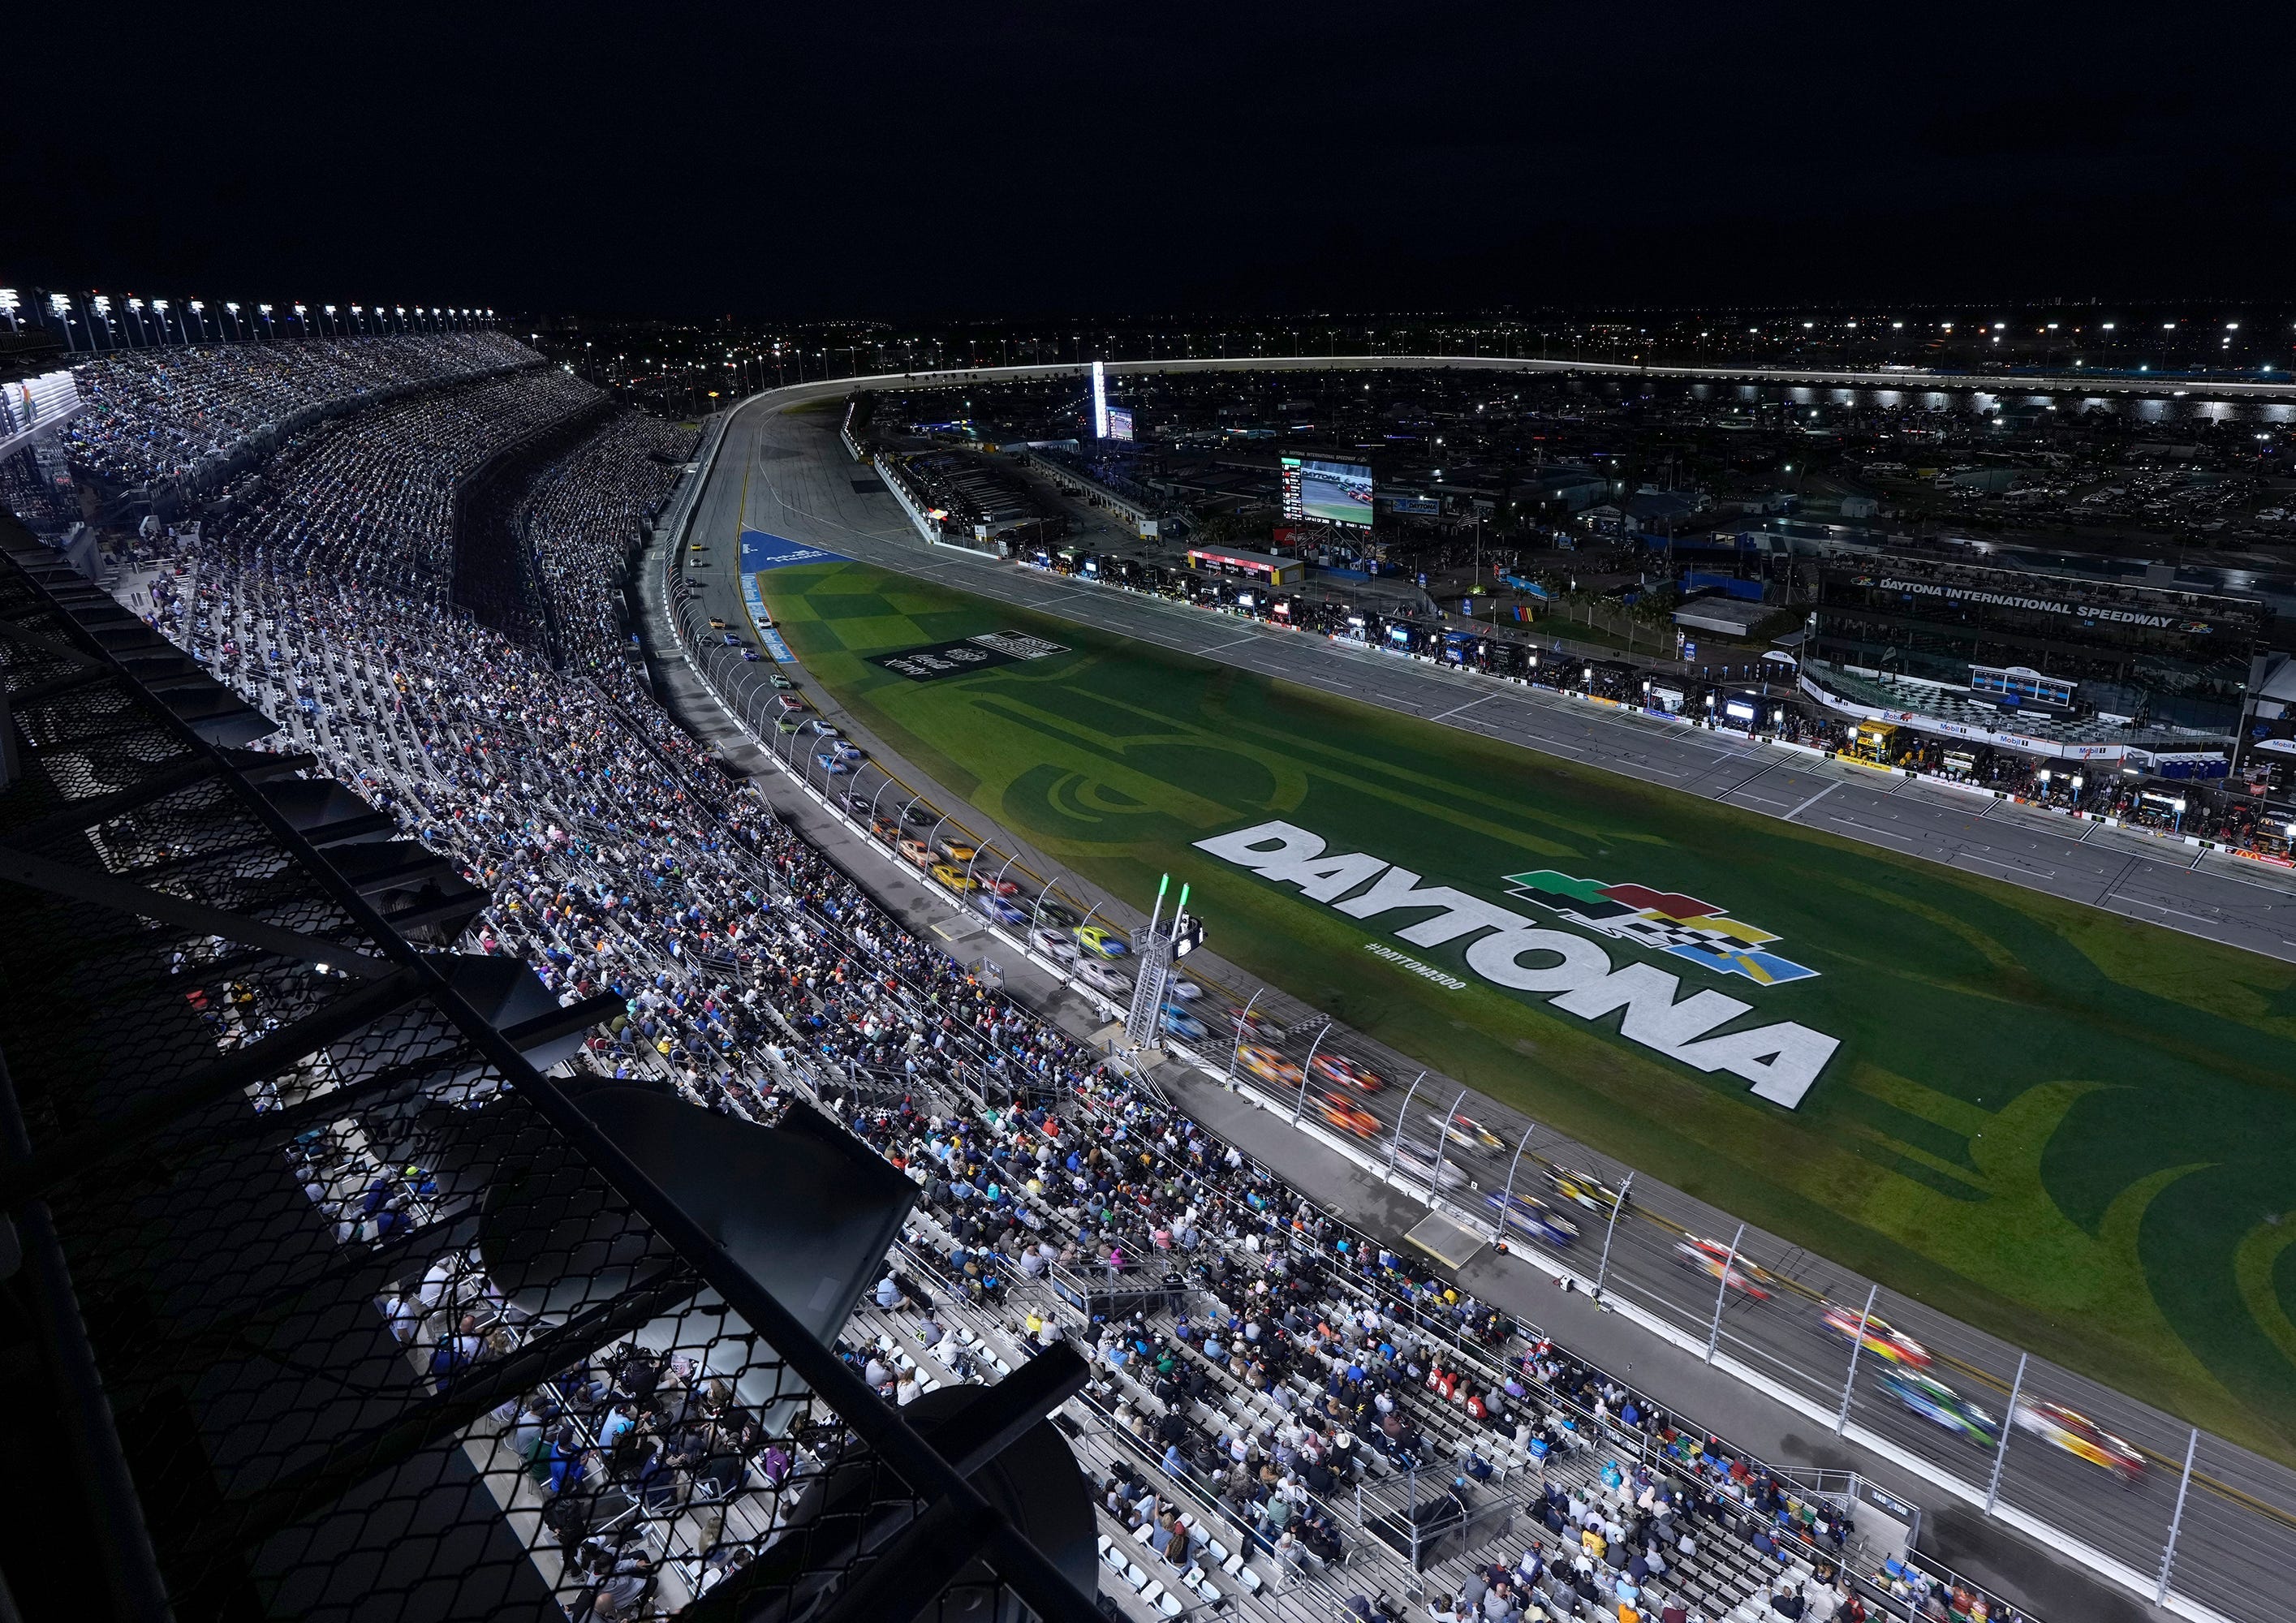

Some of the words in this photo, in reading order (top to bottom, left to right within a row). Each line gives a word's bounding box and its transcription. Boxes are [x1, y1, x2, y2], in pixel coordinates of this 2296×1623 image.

[1302, 471, 1341, 481] DAYTONA
[1880, 579, 1942, 596] DAYTONA
[1945, 588, 2071, 614] INTERNATIONAL
[2076, 606, 2174, 628] SPEEDWAY
[883, 657, 931, 676] xfinity
[1884, 711, 1900, 721] Mobil
[1940, 723, 1959, 732] Mobil
[2000, 735, 2021, 746] Mobil
[2272, 740, 2292, 748] Mobil
[2259, 855, 2290, 867] McDonald's
[1191, 819, 1842, 1110] DAYTONA
[1363, 942, 1467, 990] #DAYTONA500
[1429, 1371, 1438, 1384] 8
[1439, 1381, 1448, 1395] 8
[1467, 1402, 1478, 1414] 8
[1606, 1429, 1620, 1444] 354
[1626, 1440, 1641, 1455] 355
[1873, 1492, 1887, 1505] 149
[1894, 1504, 1907, 1516] 150
